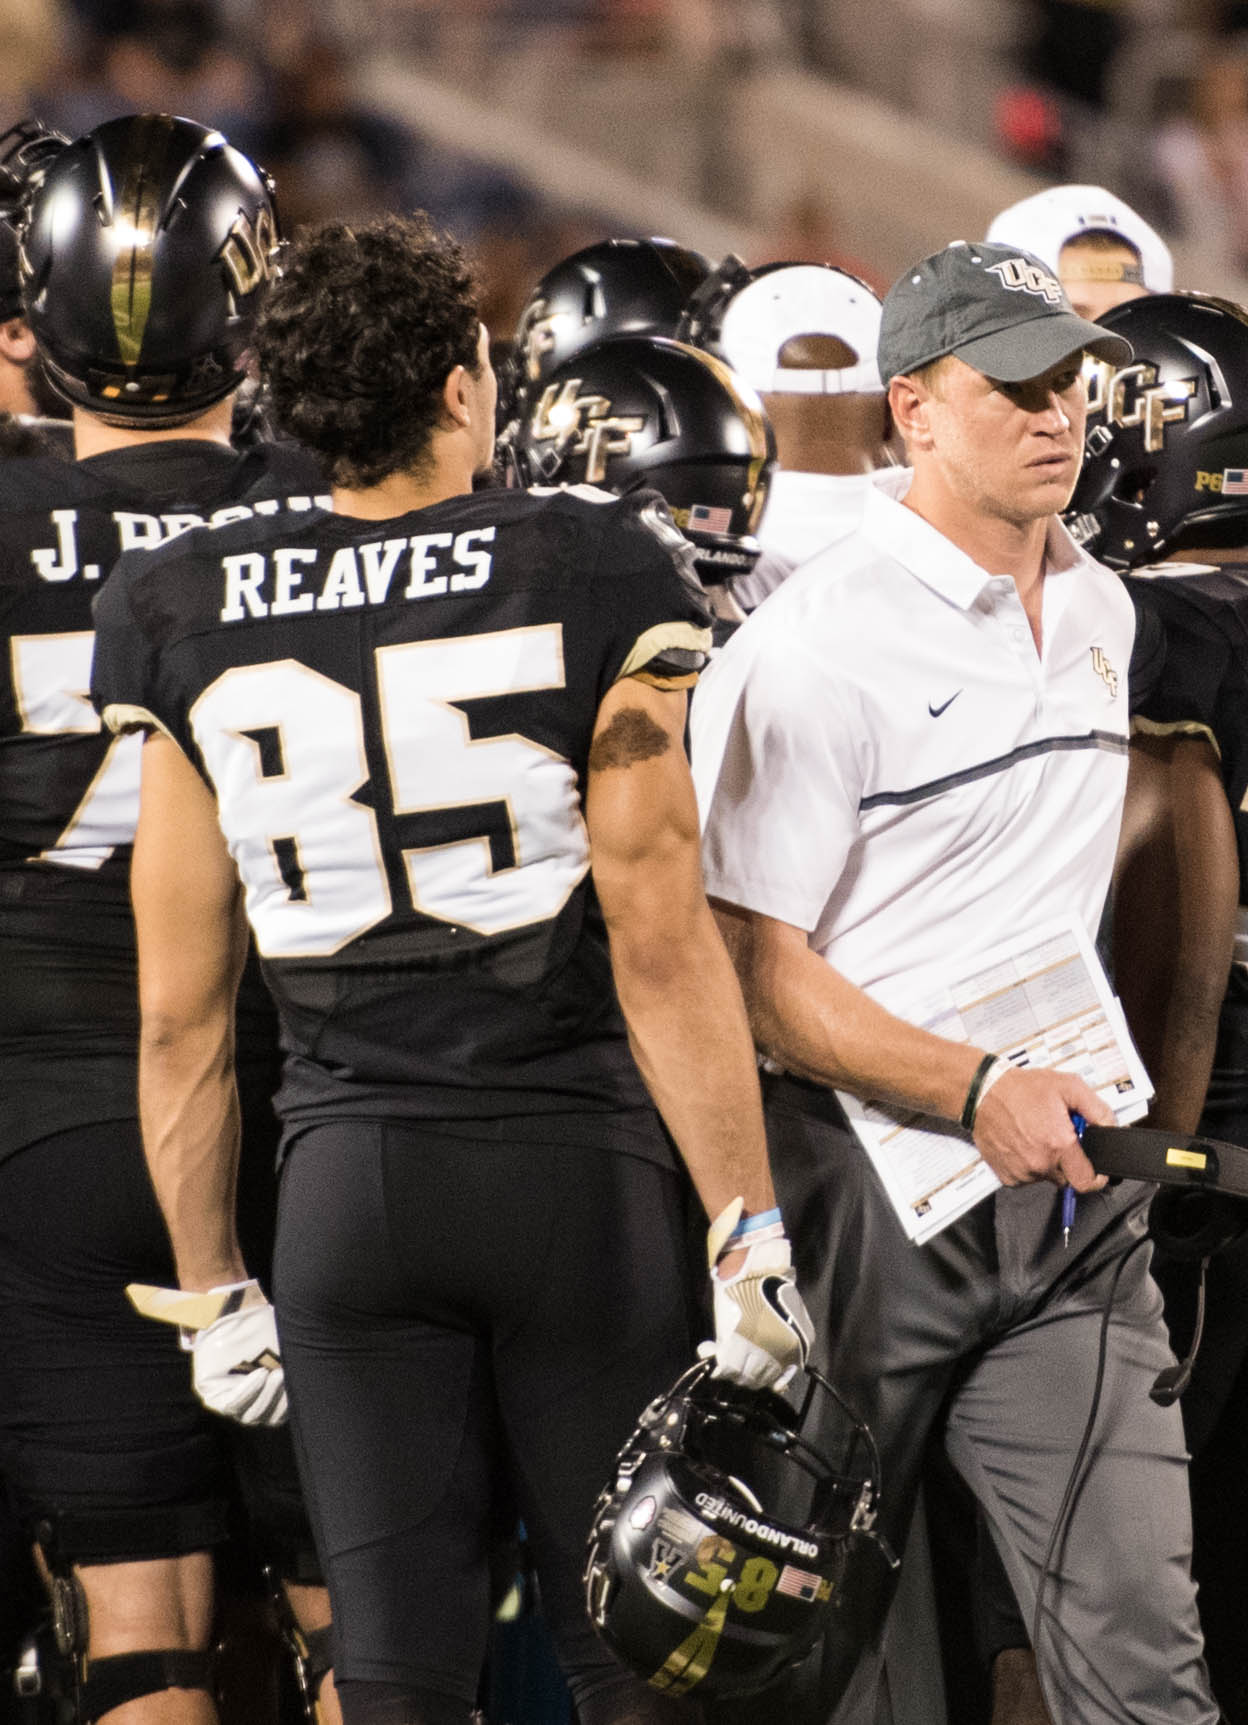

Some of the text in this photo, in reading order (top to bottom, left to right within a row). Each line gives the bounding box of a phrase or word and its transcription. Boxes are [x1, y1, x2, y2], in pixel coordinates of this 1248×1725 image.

[984, 258, 1064, 304] UCF
[31, 509, 100, 582] J.
[220, 525, 496, 623] REAVES
[694, 548, 748, 567] RLANDO
[189, 622, 592, 960] 85
